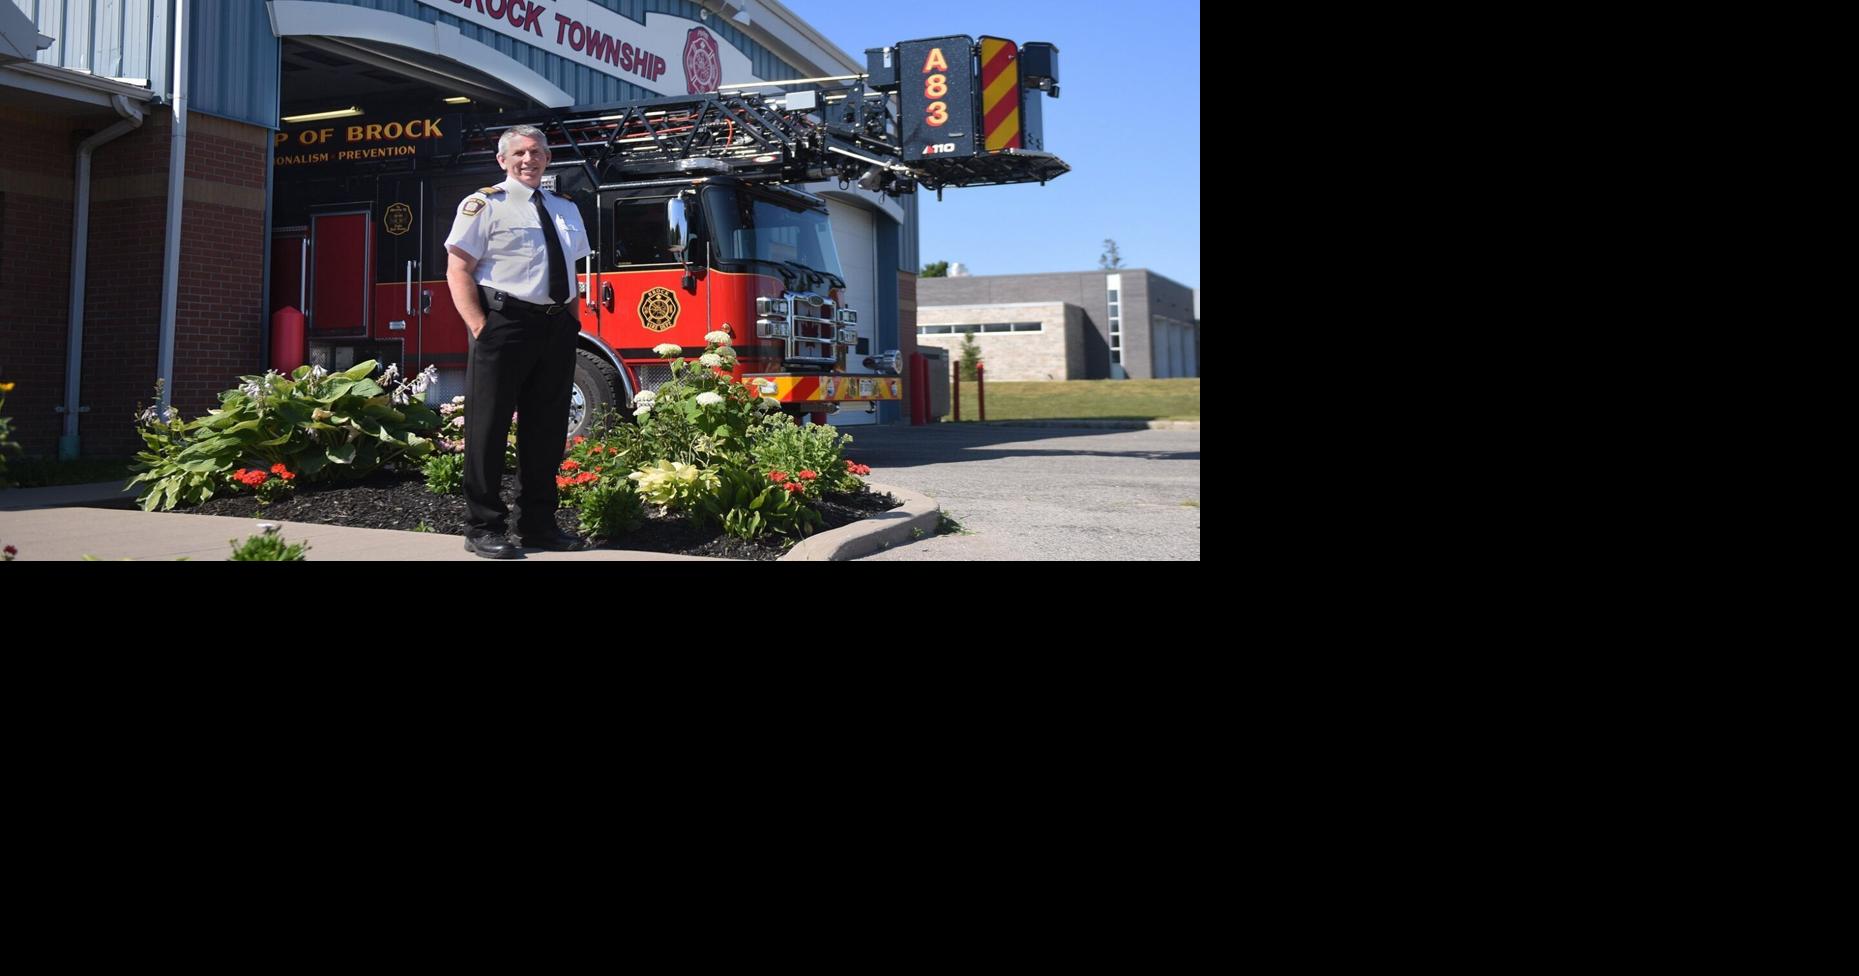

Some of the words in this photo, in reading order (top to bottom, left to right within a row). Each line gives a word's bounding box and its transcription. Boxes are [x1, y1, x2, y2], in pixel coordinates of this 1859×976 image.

[449, 0, 546, 37] OCK
[555, 13, 666, 83] TOWNSHIP
[299, 128, 335, 146] OF
[347, 117, 444, 142] BROCK
[274, 152, 329, 167] ONALISM
[338, 145, 416, 161] PREVENTION
